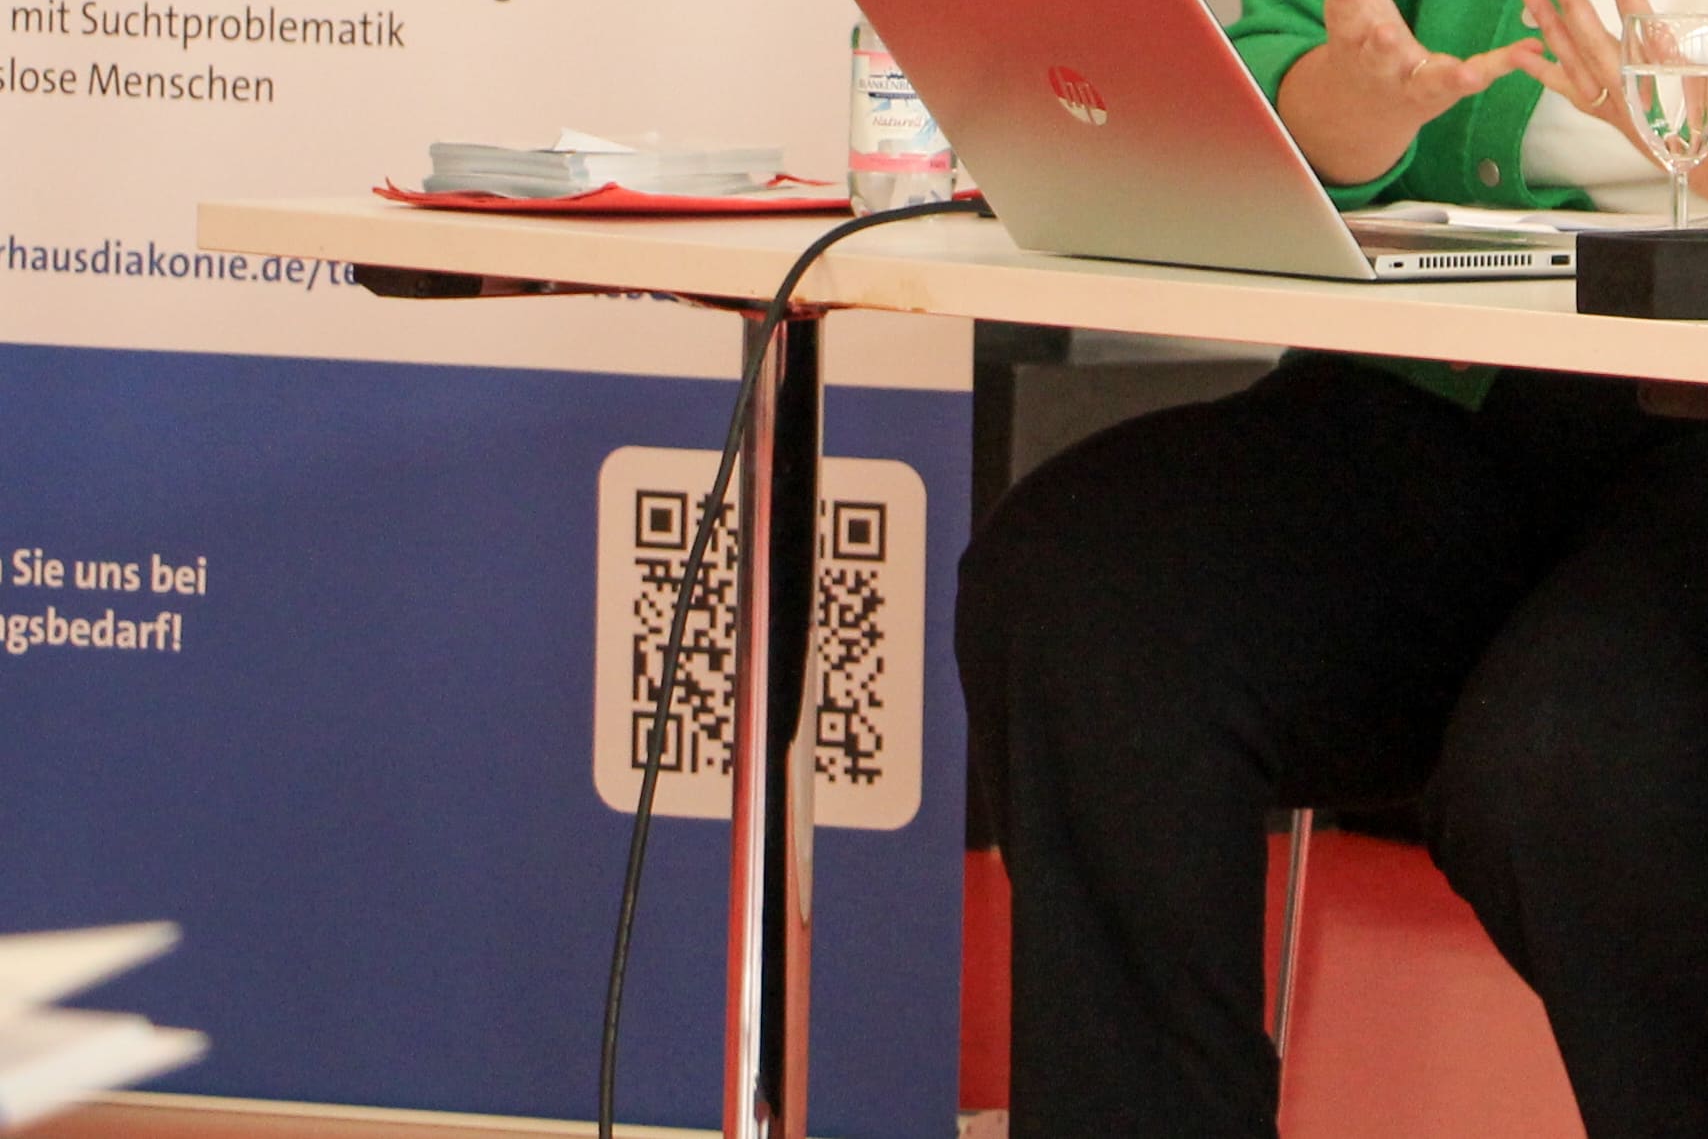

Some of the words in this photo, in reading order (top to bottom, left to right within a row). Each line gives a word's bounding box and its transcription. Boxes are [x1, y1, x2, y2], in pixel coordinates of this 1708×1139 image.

[81, 1, 405, 51] Suchtproblematik
[88, 62, 275, 103] Menschen
[13, 548, 65, 588] Sie
[75, 560, 141, 592] uns
[151, 553, 208, 595] bei
